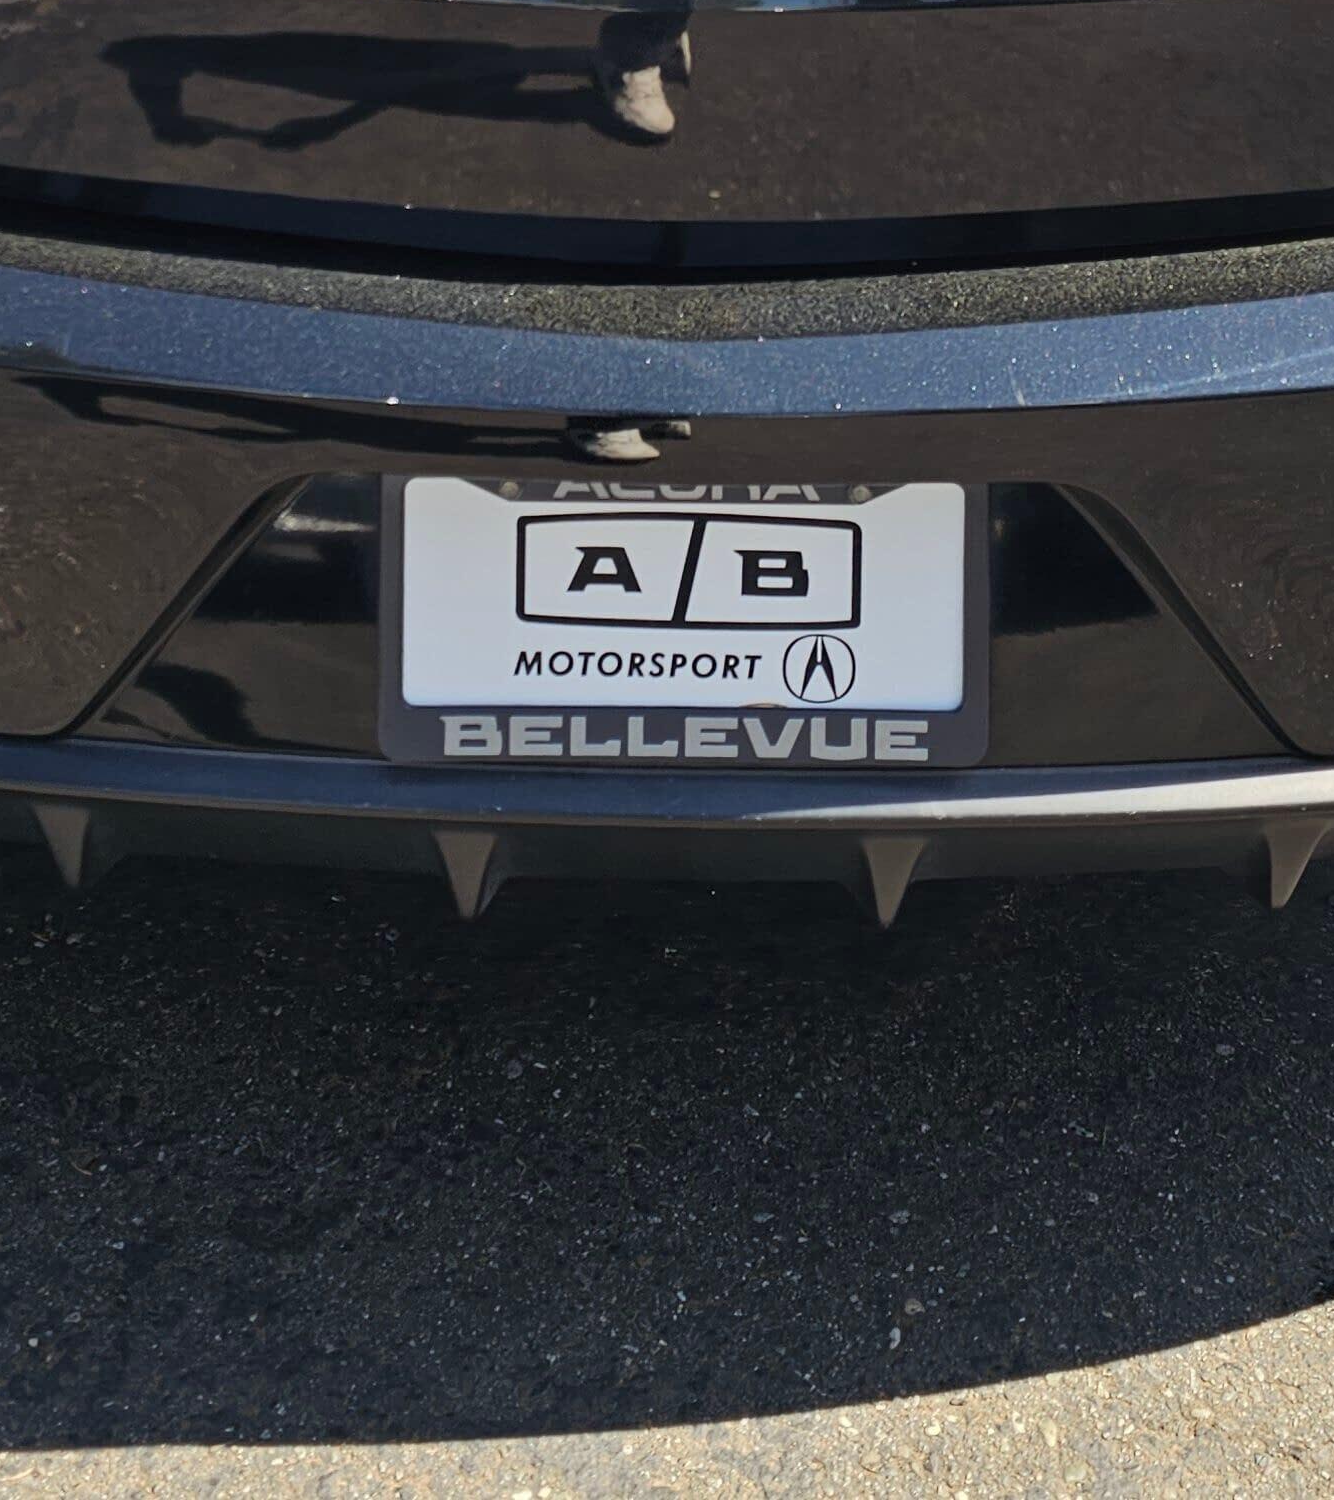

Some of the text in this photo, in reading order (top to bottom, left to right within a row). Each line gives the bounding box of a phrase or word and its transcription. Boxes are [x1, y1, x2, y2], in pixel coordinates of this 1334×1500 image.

[567, 547, 808, 596] A B
[513, 650, 763, 680] MOTORSPORT
[439, 715, 928, 762] BELLEVUE
